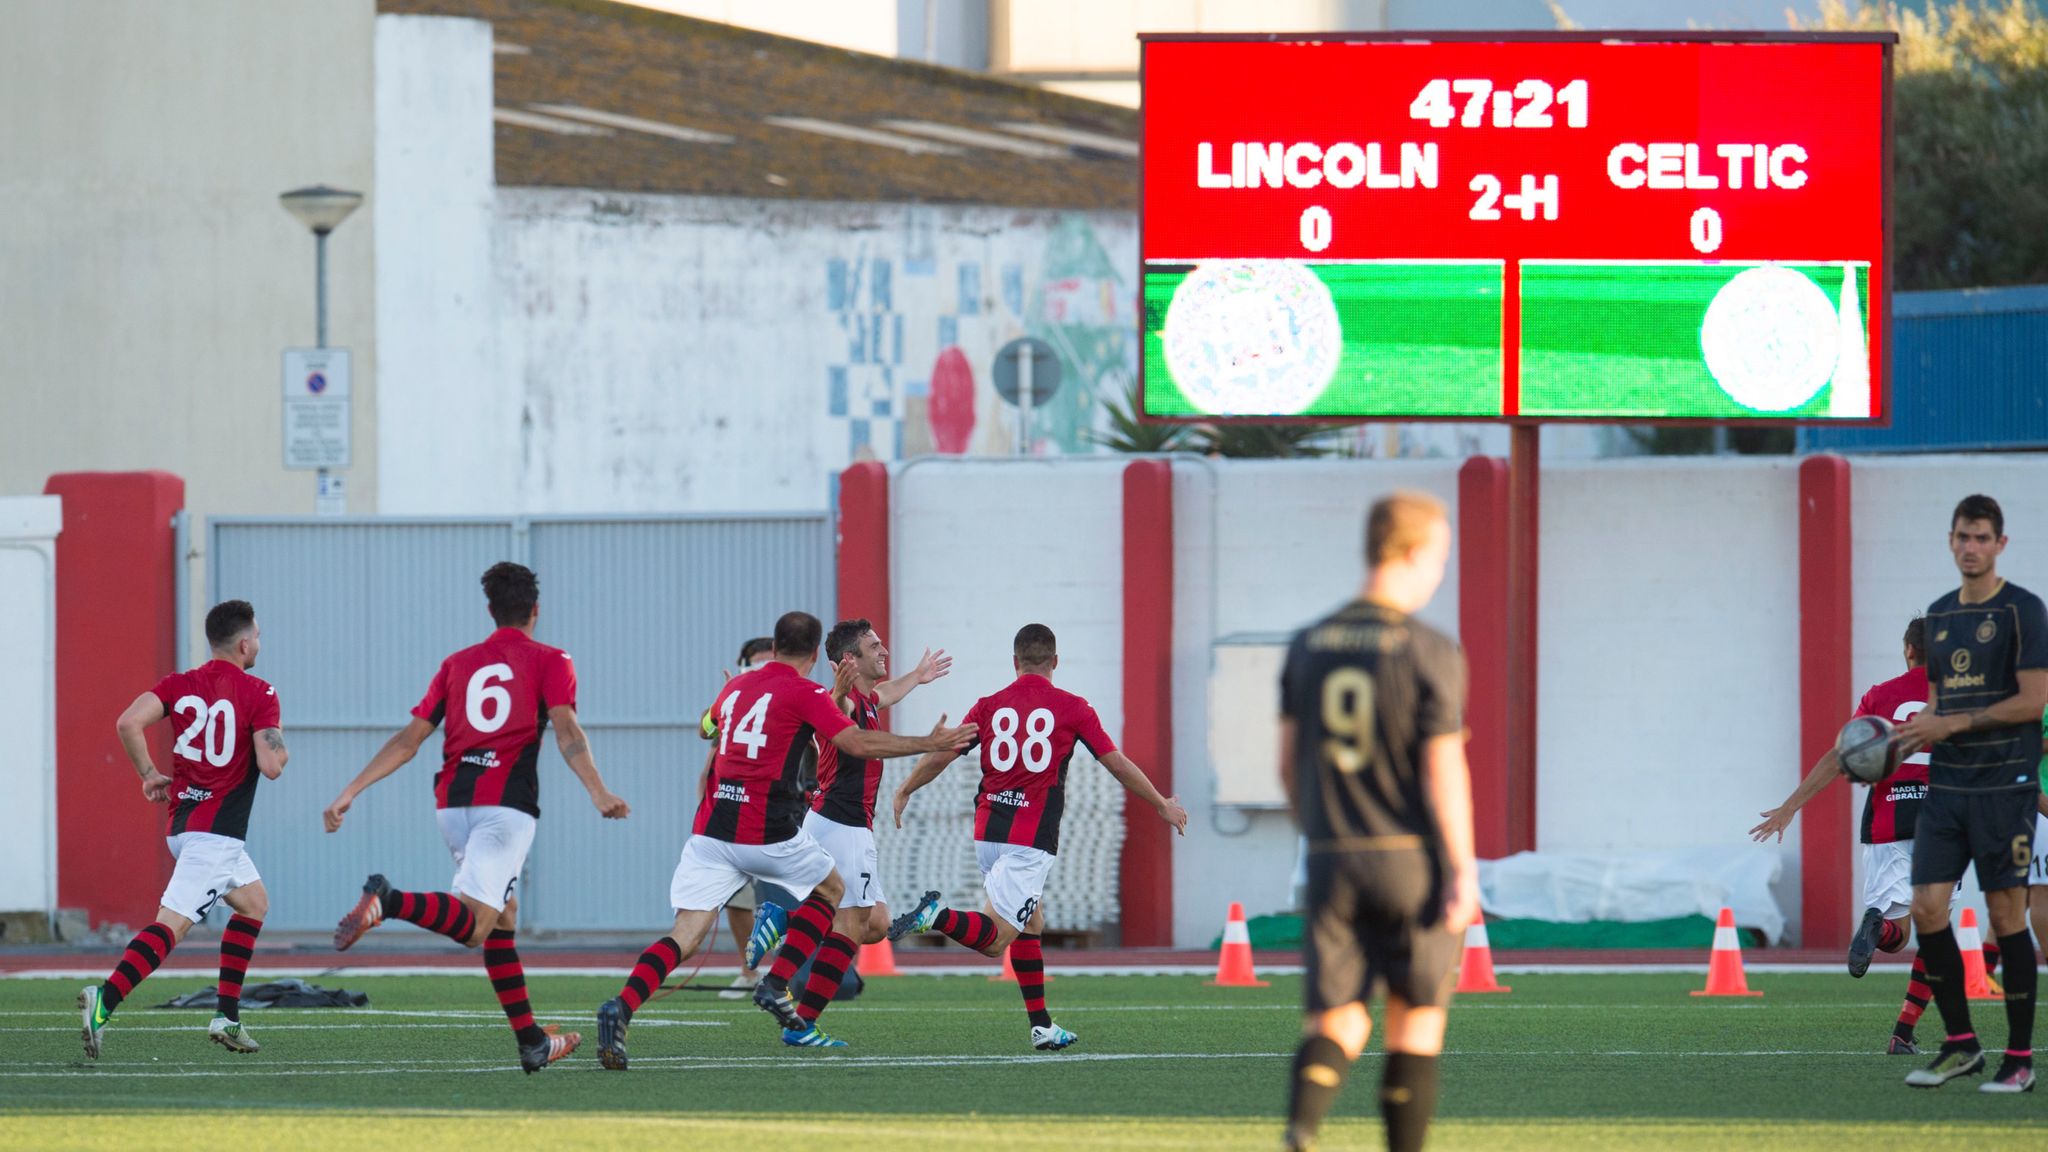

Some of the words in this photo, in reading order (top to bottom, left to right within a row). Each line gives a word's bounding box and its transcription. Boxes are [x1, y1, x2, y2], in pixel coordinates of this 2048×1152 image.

[1409, 79, 1588, 127] 47:21
[1197, 142, 1438, 189] LINCOLN
[1607, 143, 1808, 189] CELTIC
[1468, 174, 1559, 220] 2-H
[1300, 206, 1332, 251] 0
[1691, 207, 1723, 253] 0
[465, 662, 514, 733] 6
[1320, 665, 1375, 773] 9
[173, 694, 236, 767] 20
[720, 689, 773, 760] 14
[990, 707, 1055, 773] 88
[986, 793, 1030, 808] GIBRALTAR
[1016, 792, 1026, 800] IN
[1891, 785, 1917, 794] MADE
[1918, 785, 1928, 793] IN
[2011, 834, 2031, 867] 6
[861, 872, 871, 900] 7
